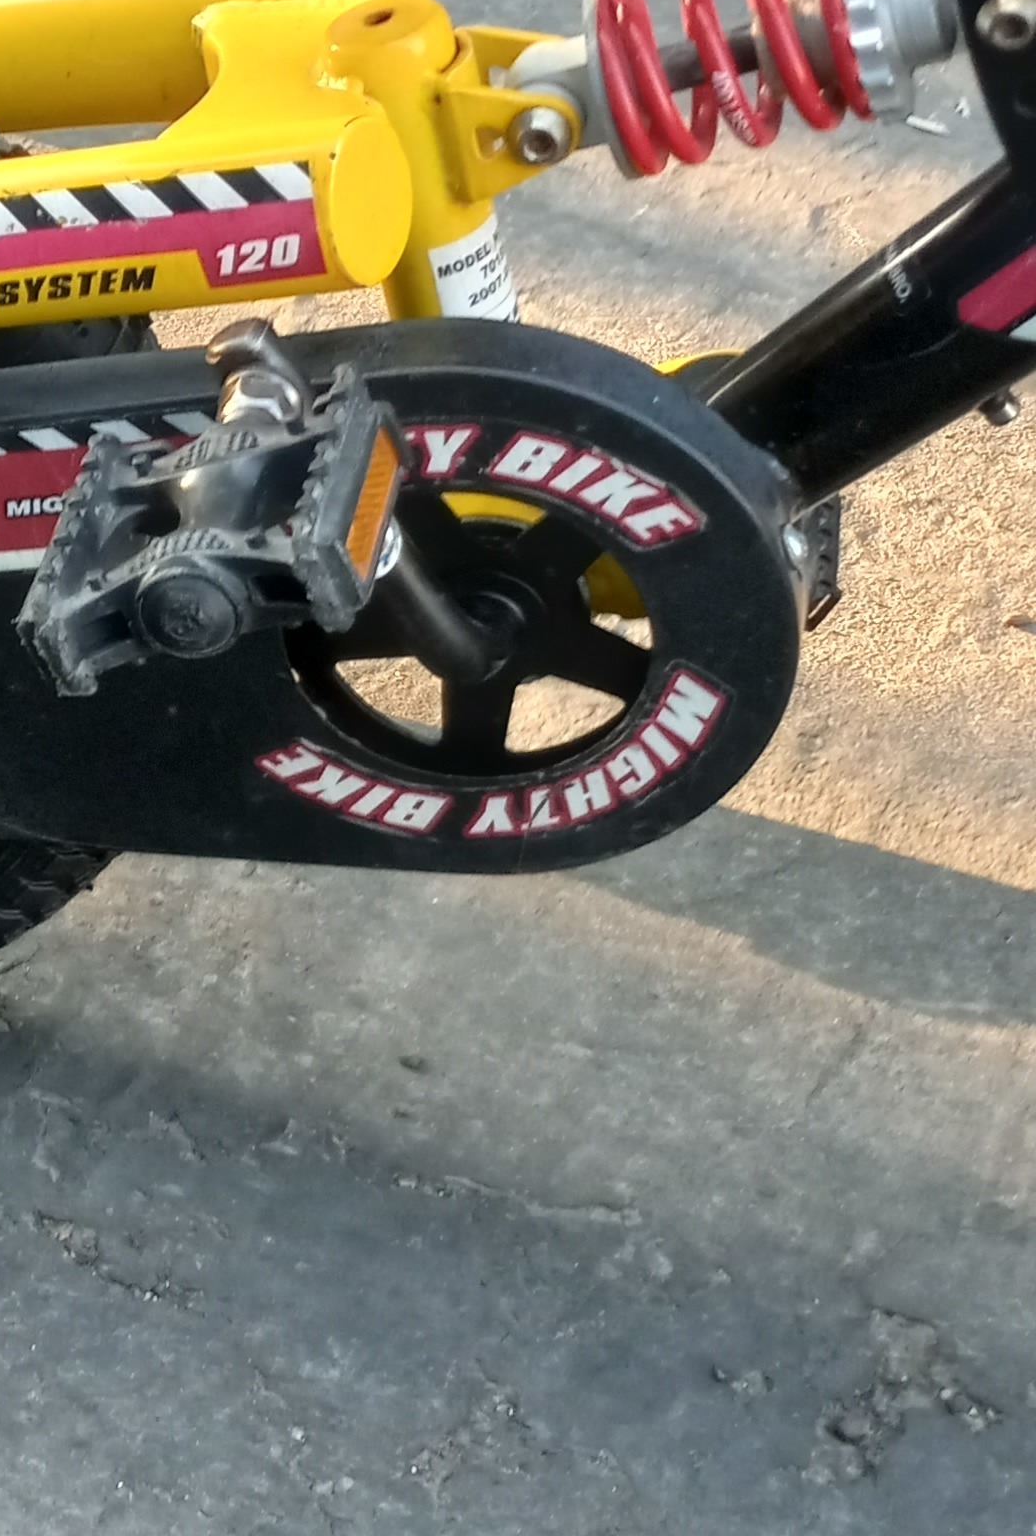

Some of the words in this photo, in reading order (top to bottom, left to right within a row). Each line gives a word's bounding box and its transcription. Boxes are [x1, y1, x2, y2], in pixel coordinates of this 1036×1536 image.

[215, 233, 302, 276] 120
[437, 243, 491, 279] MODEL
[6, 495, 63, 518] MIG
[493, 437, 701, 545] BIKE
[468, 670, 722, 833] MIGHTY
[261, 743, 448, 832] BIKE
